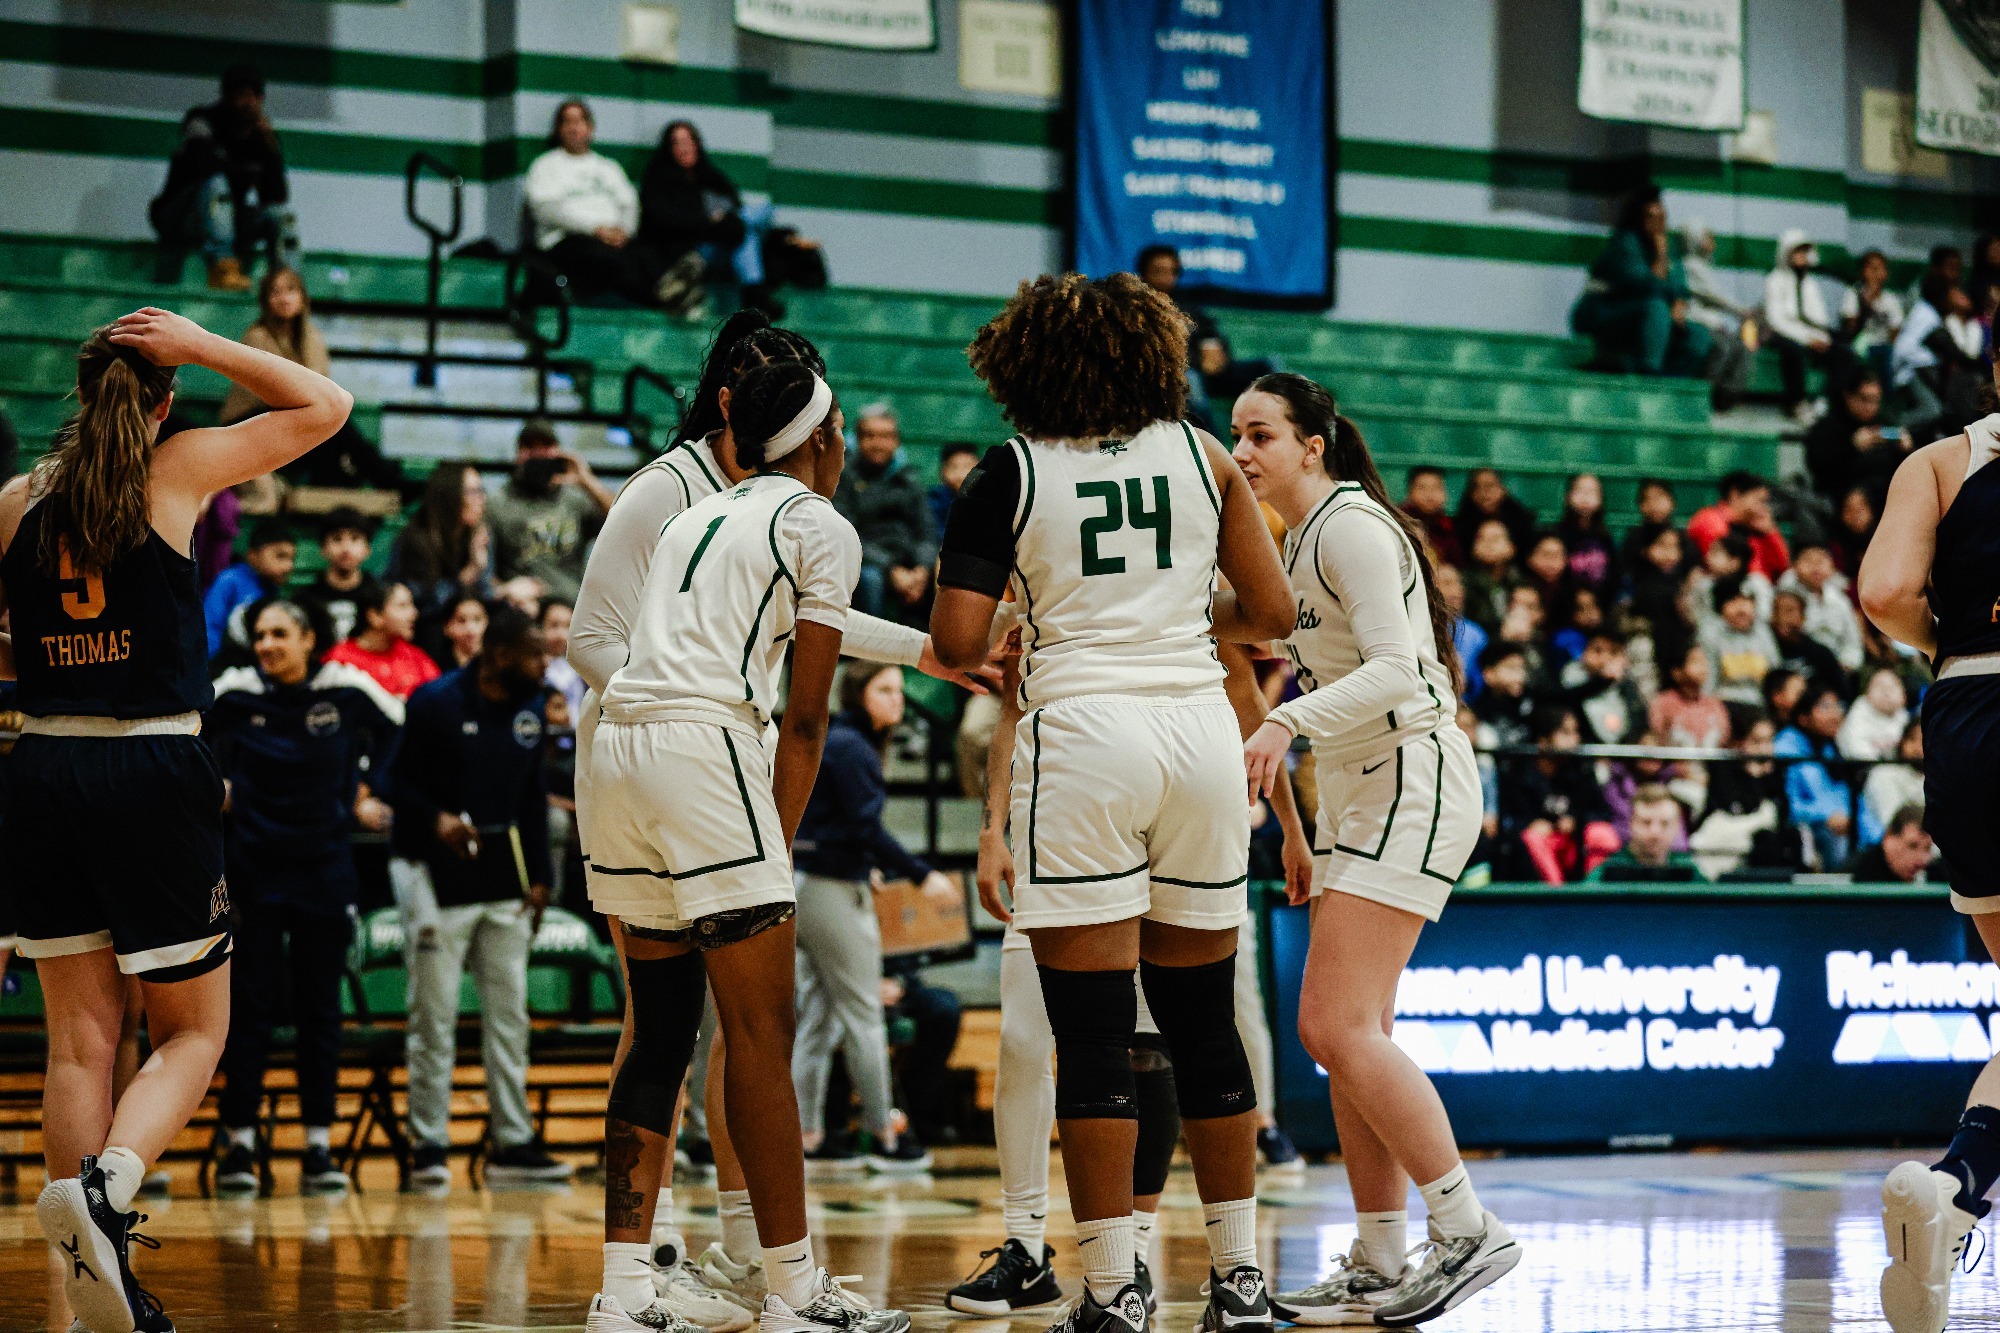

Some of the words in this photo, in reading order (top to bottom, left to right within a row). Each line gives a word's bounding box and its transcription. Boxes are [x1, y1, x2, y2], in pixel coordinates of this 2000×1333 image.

[679, 515, 727, 592] 1
[1076, 475, 1172, 576] 24
[41, 629, 131, 666] THOMAS
[1545, 954, 1781, 1026] University
[1491, 1017, 1645, 1072] Medical
[1646, 1017, 1785, 1071] Center
